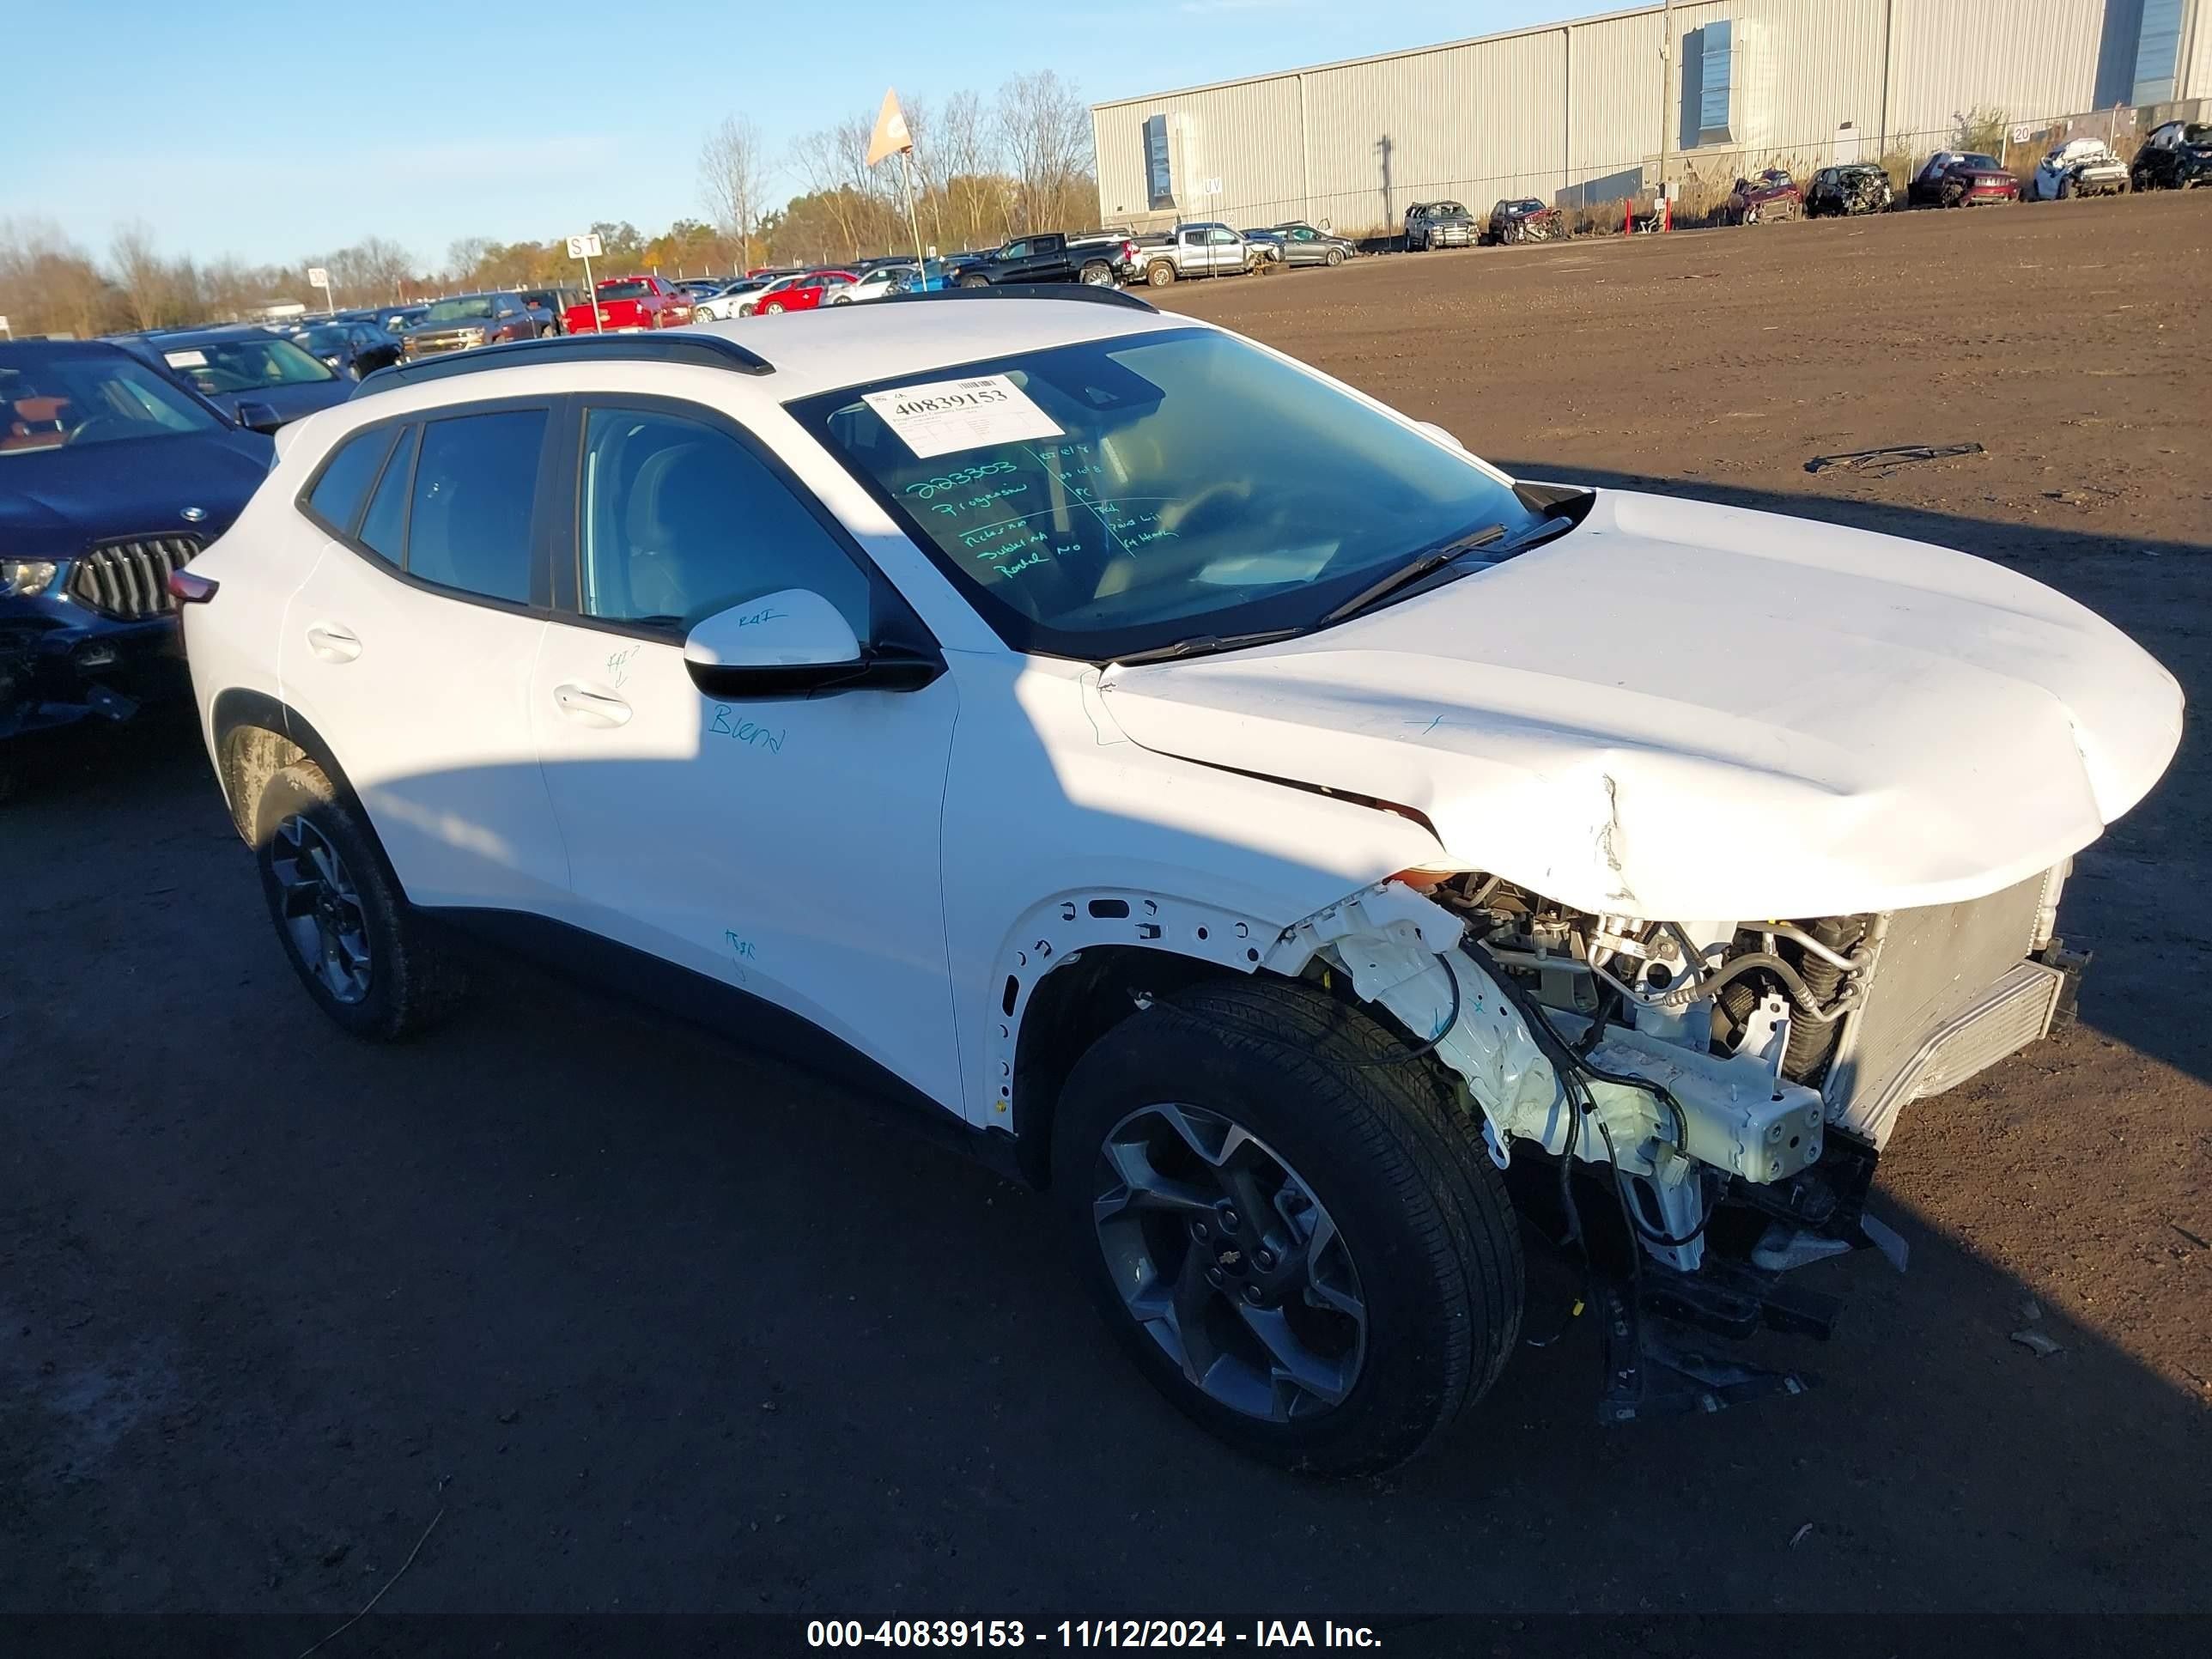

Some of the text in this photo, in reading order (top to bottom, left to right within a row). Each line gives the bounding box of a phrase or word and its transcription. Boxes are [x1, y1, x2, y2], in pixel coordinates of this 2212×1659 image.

[2015, 127, 2029, 140] 20
[896, 390, 1008, 416] 40839153
[906, 461, 1018, 499] 223303
